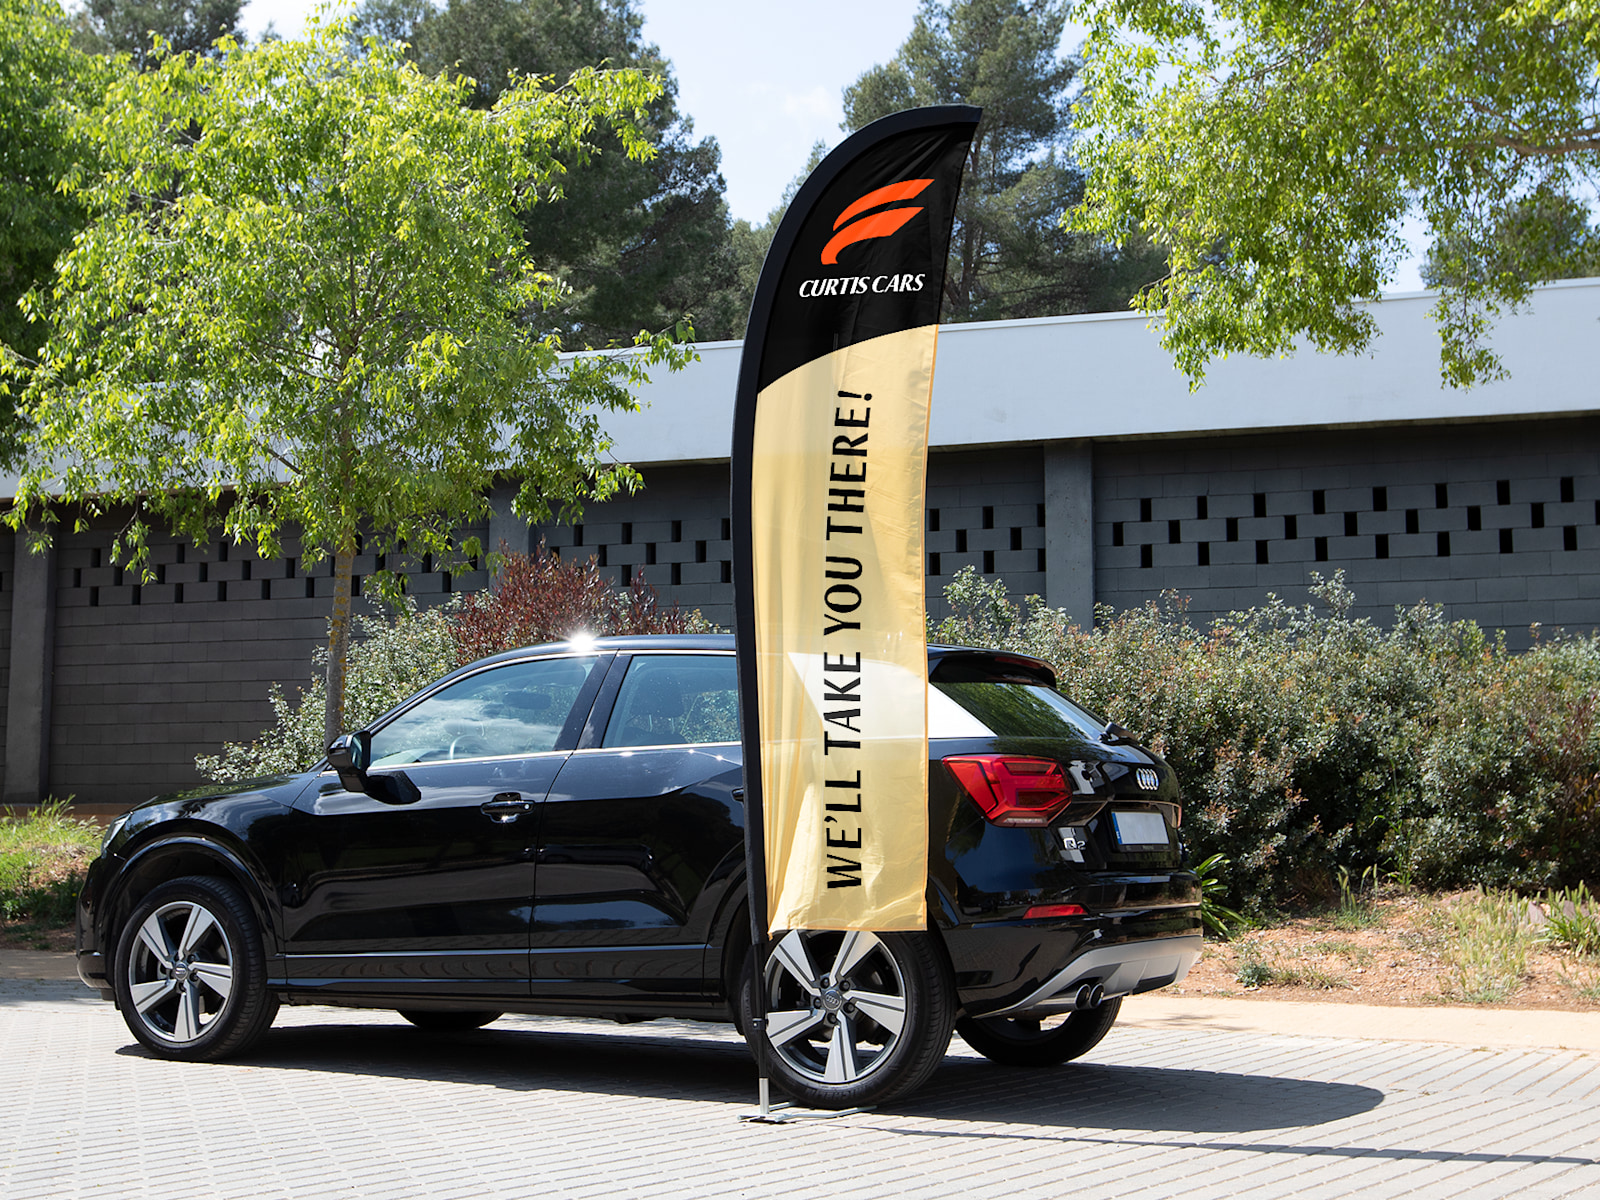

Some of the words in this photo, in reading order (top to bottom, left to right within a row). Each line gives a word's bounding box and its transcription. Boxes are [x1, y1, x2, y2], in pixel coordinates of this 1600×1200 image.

[799, 276, 871, 298] CURTIS
[872, 273, 926, 293] CARS
[826, 390, 872, 541] THERE!
[823, 555, 863, 636] YOU
[823, 651, 861, 756] TAKE
[824, 769, 862, 889] WE'LL
[1063, 837, 1086, 851] Q2
